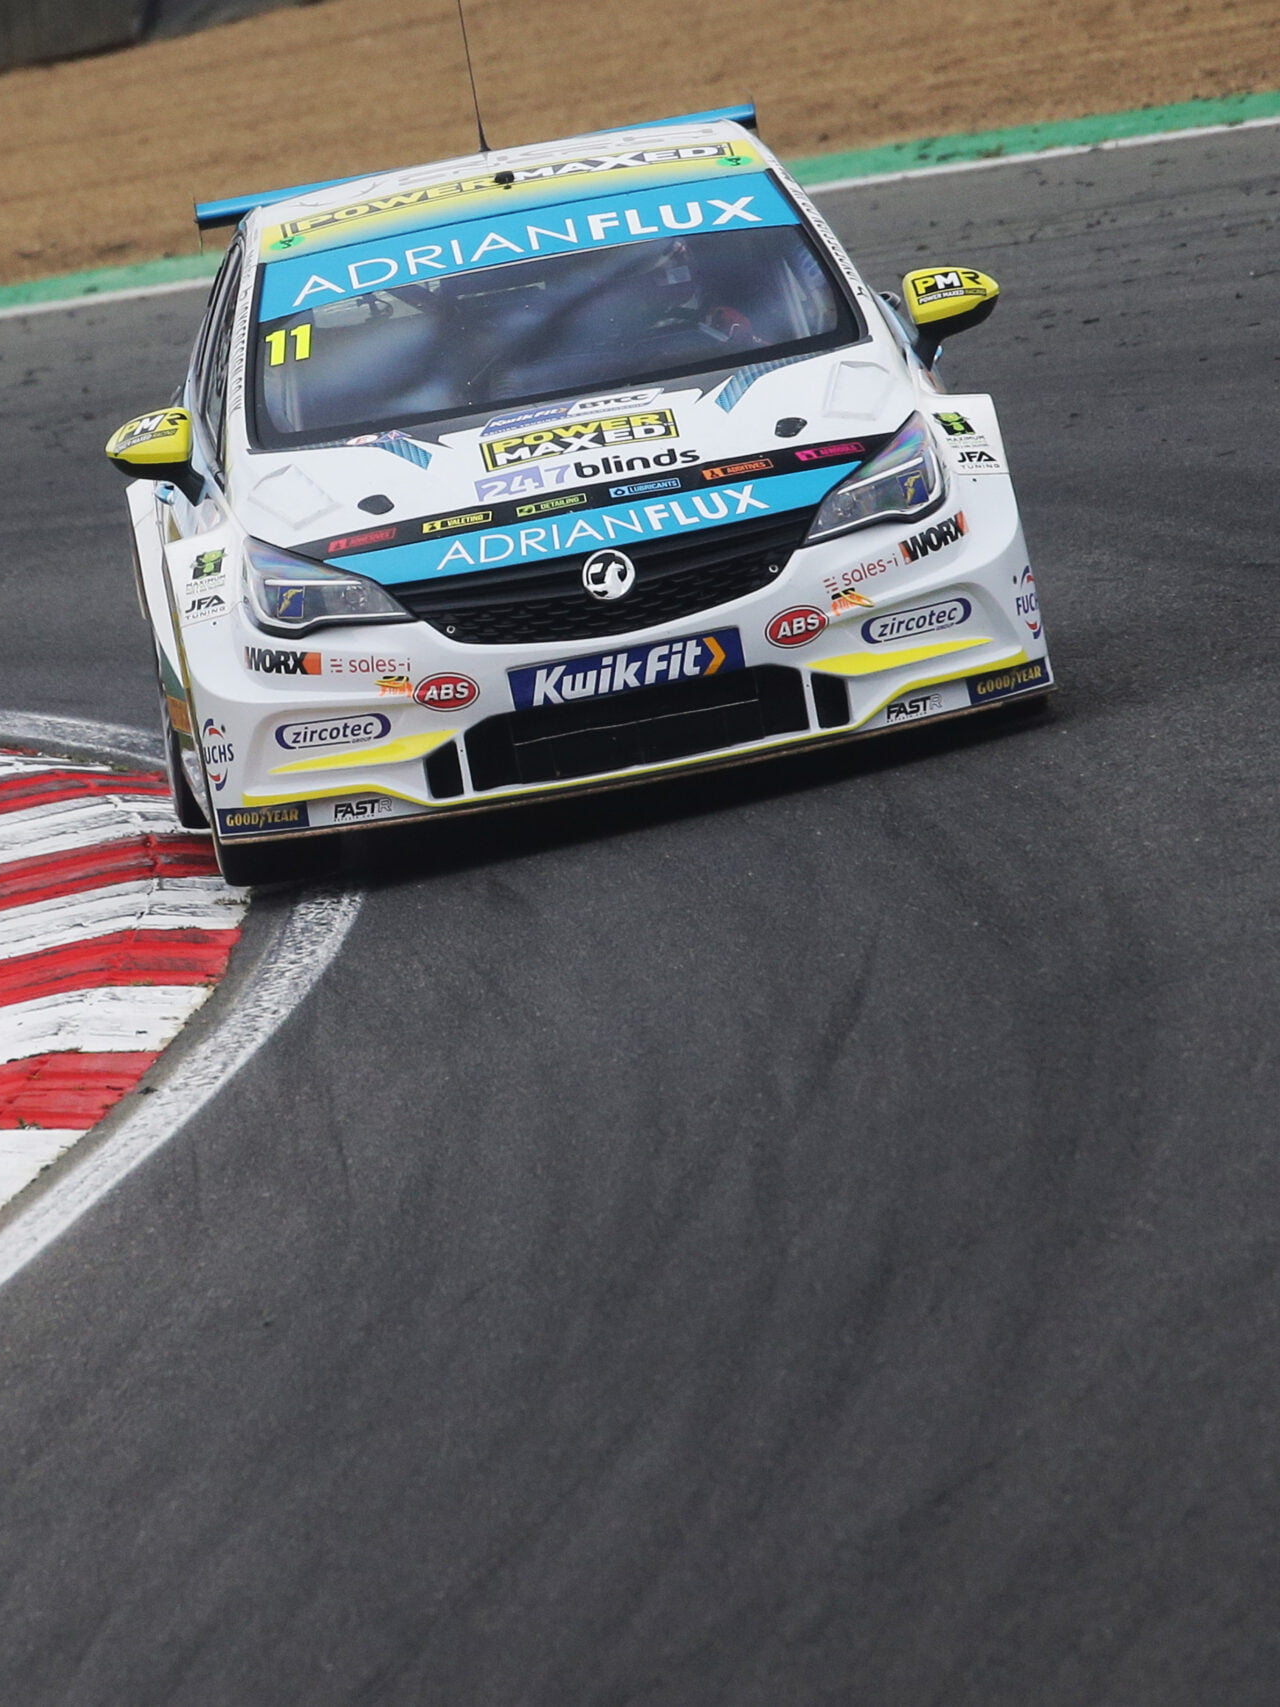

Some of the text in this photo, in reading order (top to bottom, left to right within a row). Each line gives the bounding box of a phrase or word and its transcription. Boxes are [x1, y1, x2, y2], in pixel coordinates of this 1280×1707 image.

[513, 146, 719, 182] MAXED
[292, 196, 763, 306] ADRIANFLUX
[913, 271, 982, 295] PMR
[265, 323, 311, 366] 11
[492, 413, 665, 452] POWER
[495, 423, 667, 466] MAXED
[958, 451, 997, 463] JFA
[629, 480, 677, 493] LUBRICANTS
[436, 484, 770, 571] ADRIANFLUX
[902, 518, 965, 563] WORX
[842, 554, 899, 586] sales-i
[185, 595, 226, 614] JFA
[186, 606, 226, 620] TUNING
[776, 613, 819, 639] ABS
[878, 606, 957, 637] zircotec
[245, 646, 309, 675] WORX
[349, 656, 411, 673] sales-i
[533, 639, 702, 707] KwikFit
[424, 682, 470, 701] ABS
[291, 721, 374, 744] zircotec
[203, 743, 234, 764] UCHS
